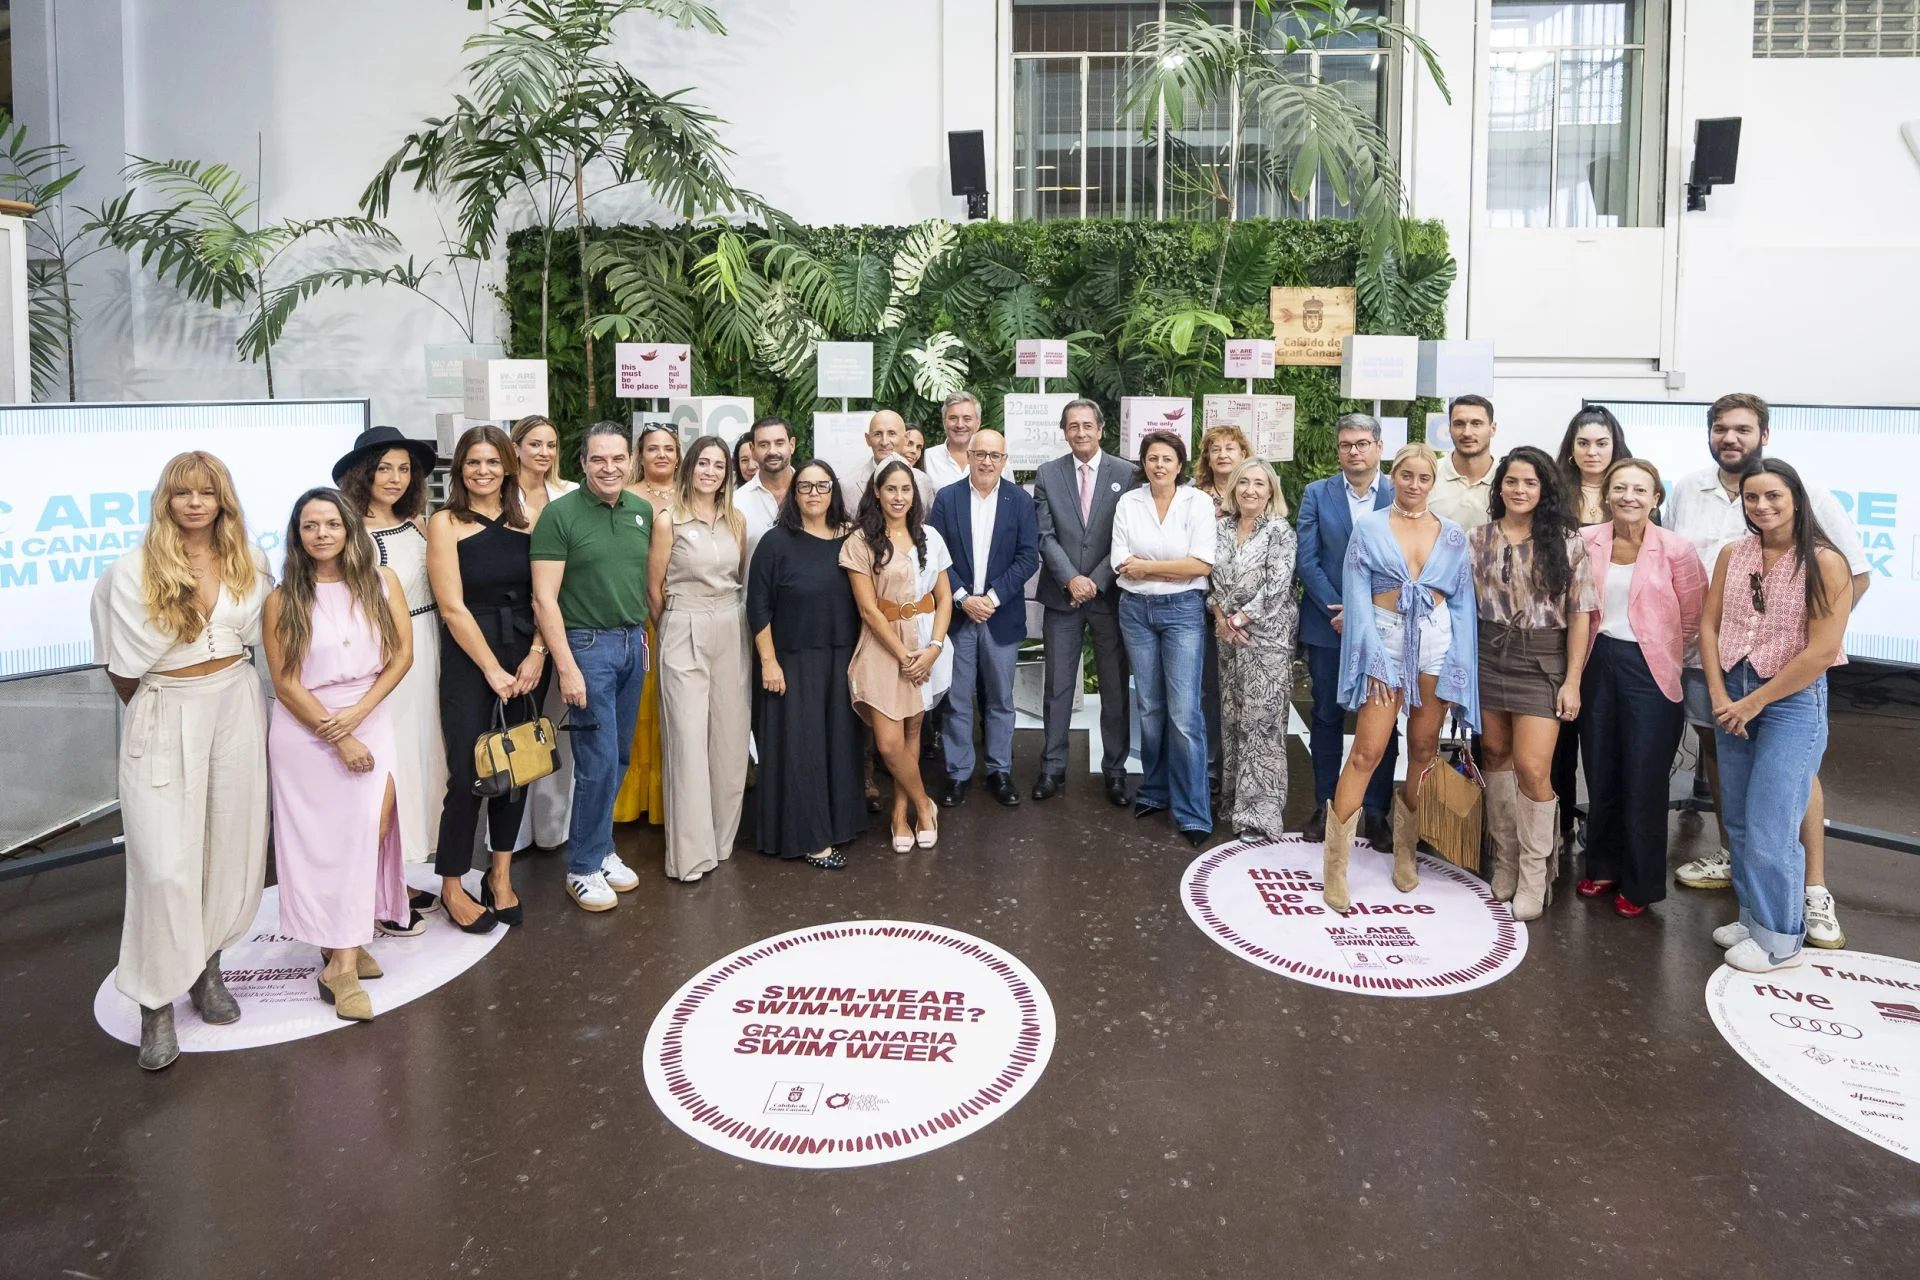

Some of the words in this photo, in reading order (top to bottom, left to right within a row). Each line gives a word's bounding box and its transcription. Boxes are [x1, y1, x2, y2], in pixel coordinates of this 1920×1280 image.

[1328, 338, 1341, 347] de
[1277, 348, 1303, 358] Gran
[1007, 401, 1023, 415] 22
[1248, 868, 1313, 880] this
[1255, 882, 1325, 892] mus
[1259, 891, 1304, 903] be
[1266, 903, 1326, 916] the
[1339, 902, 1436, 919] place
[1366, 926, 1411, 934] ARE
[253, 967, 316, 976] CANARIA
[256, 972, 312, 981] WEEK
[762, 985, 965, 1005] SWIM-WEAR
[1753, 984, 1834, 1010] rtve
[732, 999, 986, 1022] SWIM-WHERE?
[742, 1024, 825, 1040] GRAN
[828, 1029, 957, 1045] CANARIA
[733, 1038, 838, 1057] SWIM
[846, 1043, 956, 1063] WEEK
